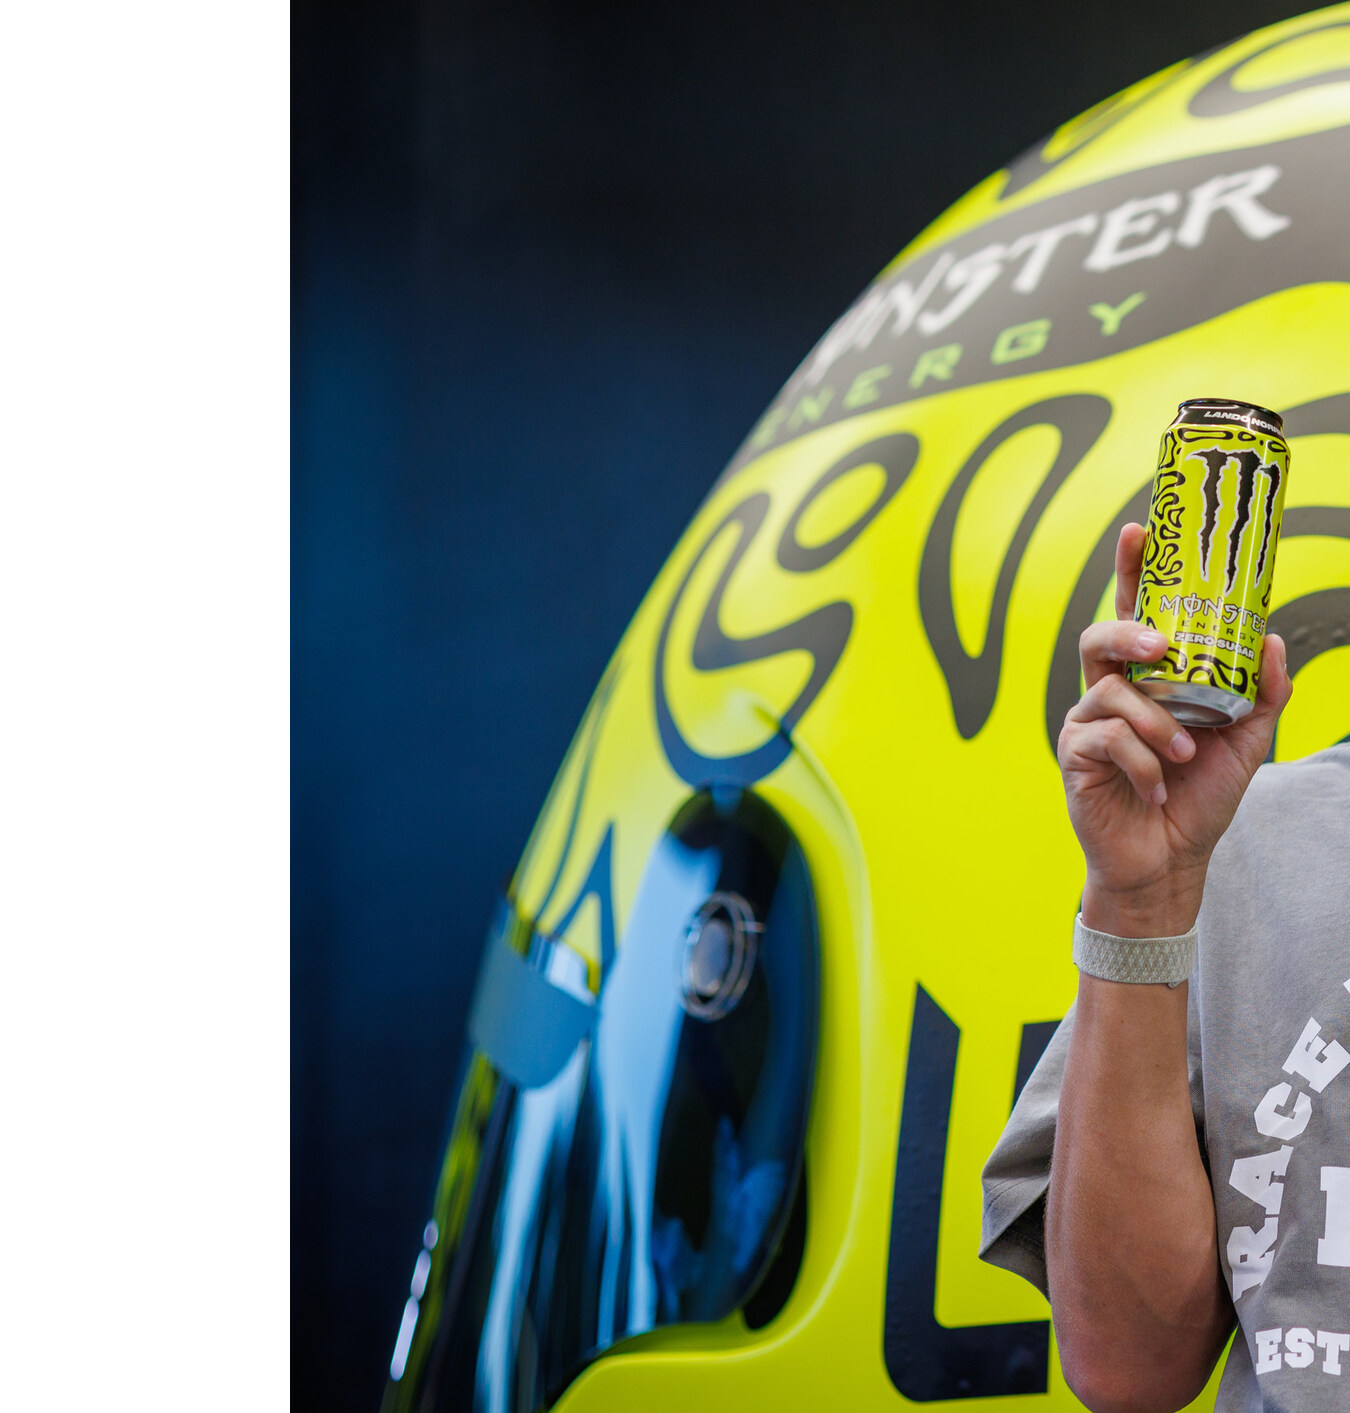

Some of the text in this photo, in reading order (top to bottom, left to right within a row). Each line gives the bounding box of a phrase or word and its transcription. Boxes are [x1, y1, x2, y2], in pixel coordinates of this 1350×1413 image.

[774, 164, 1292, 402] NSTER
[1204, 411, 1251, 423] LANDO
[1182, 620, 1255, 643] ENERGY
[1174, 631, 1255, 661] ZERO SUGAR
